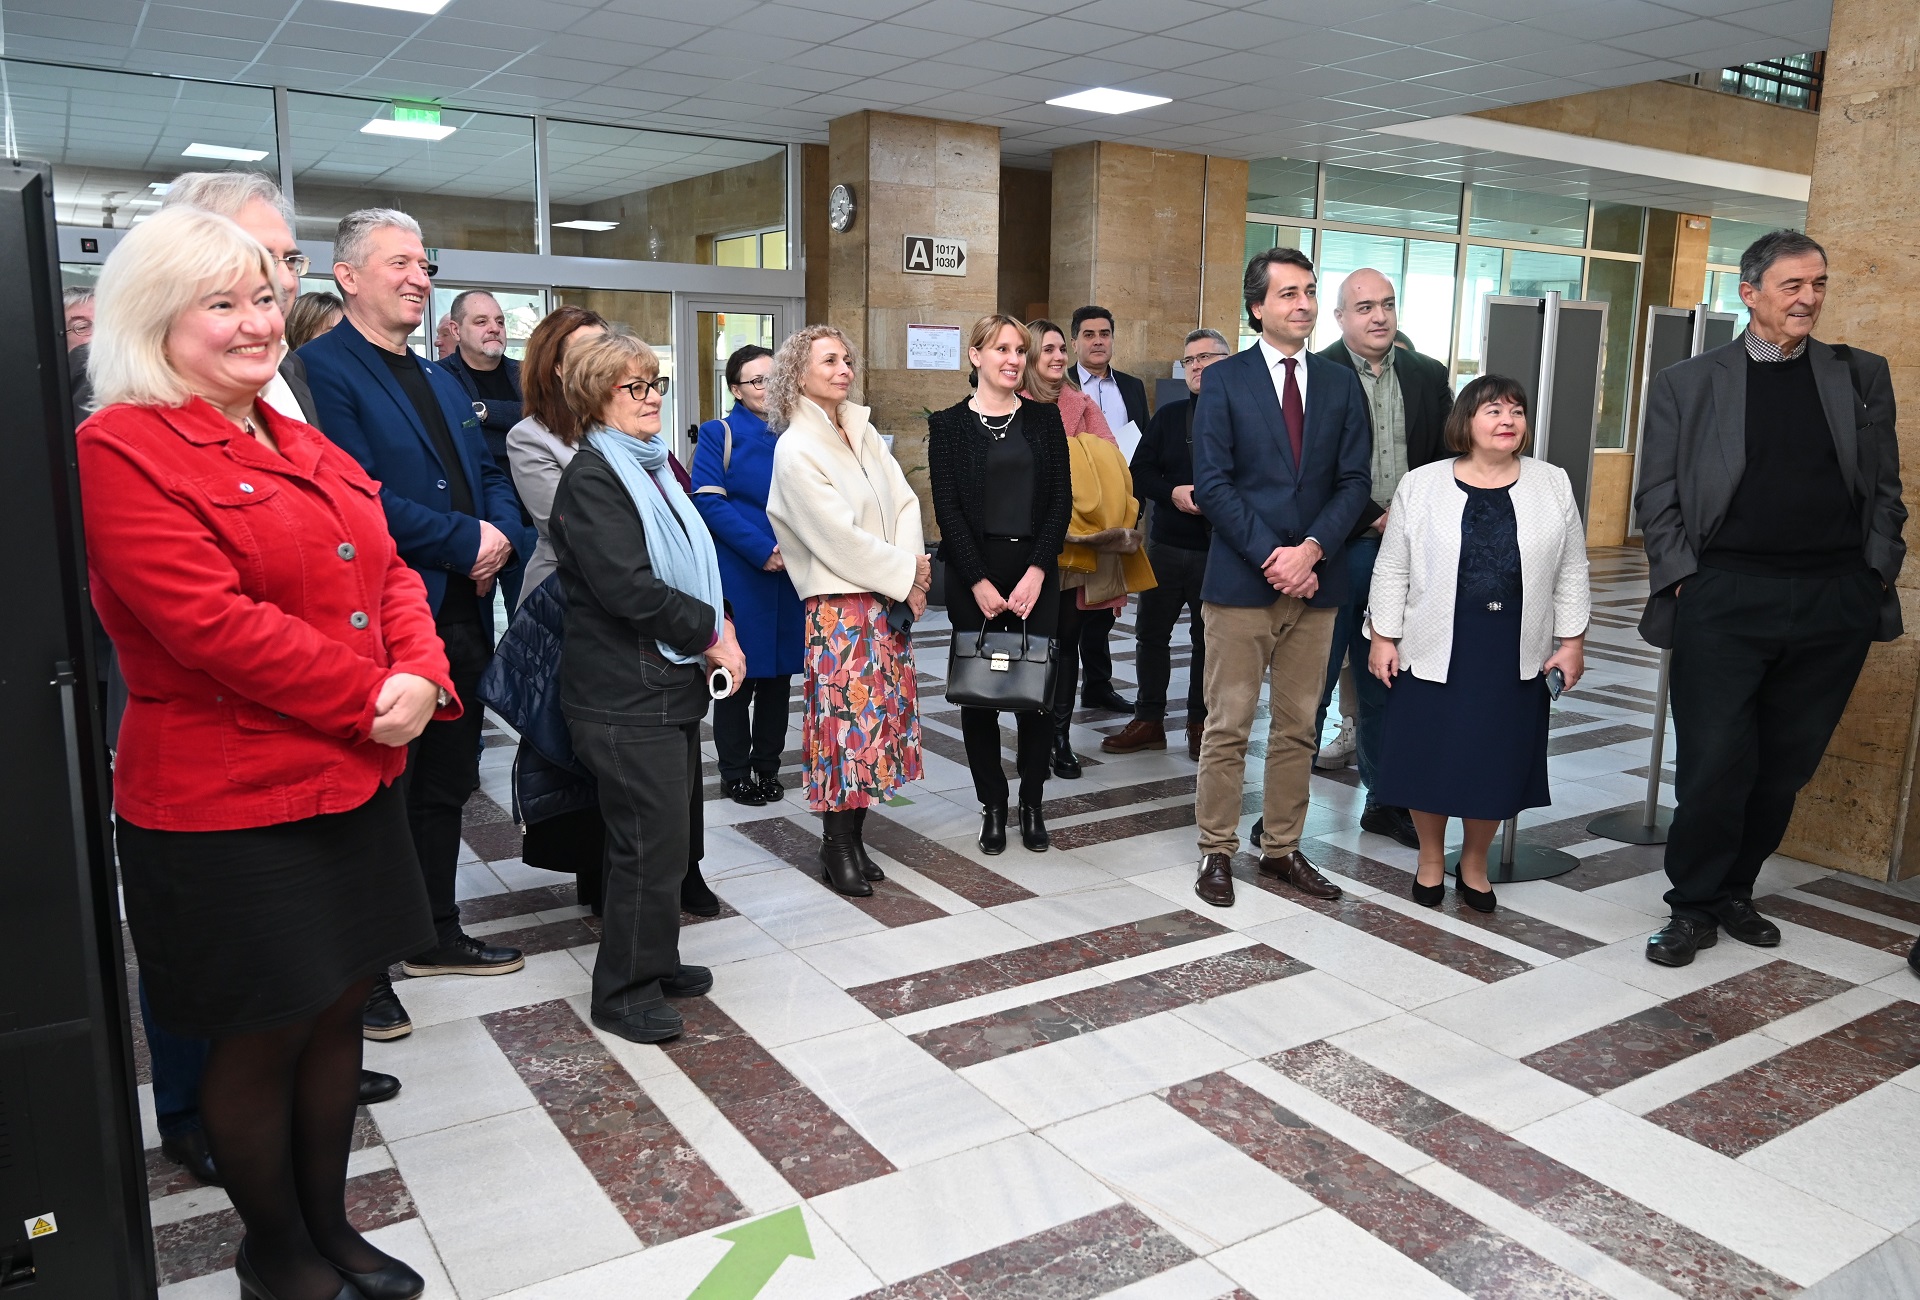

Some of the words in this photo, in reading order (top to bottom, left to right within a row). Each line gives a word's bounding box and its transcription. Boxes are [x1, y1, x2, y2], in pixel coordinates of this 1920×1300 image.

[424, 248, 438, 261] IT
[909, 240, 930, 269] A
[935, 244, 956, 255] 1017
[935, 257, 956, 268] 1030
